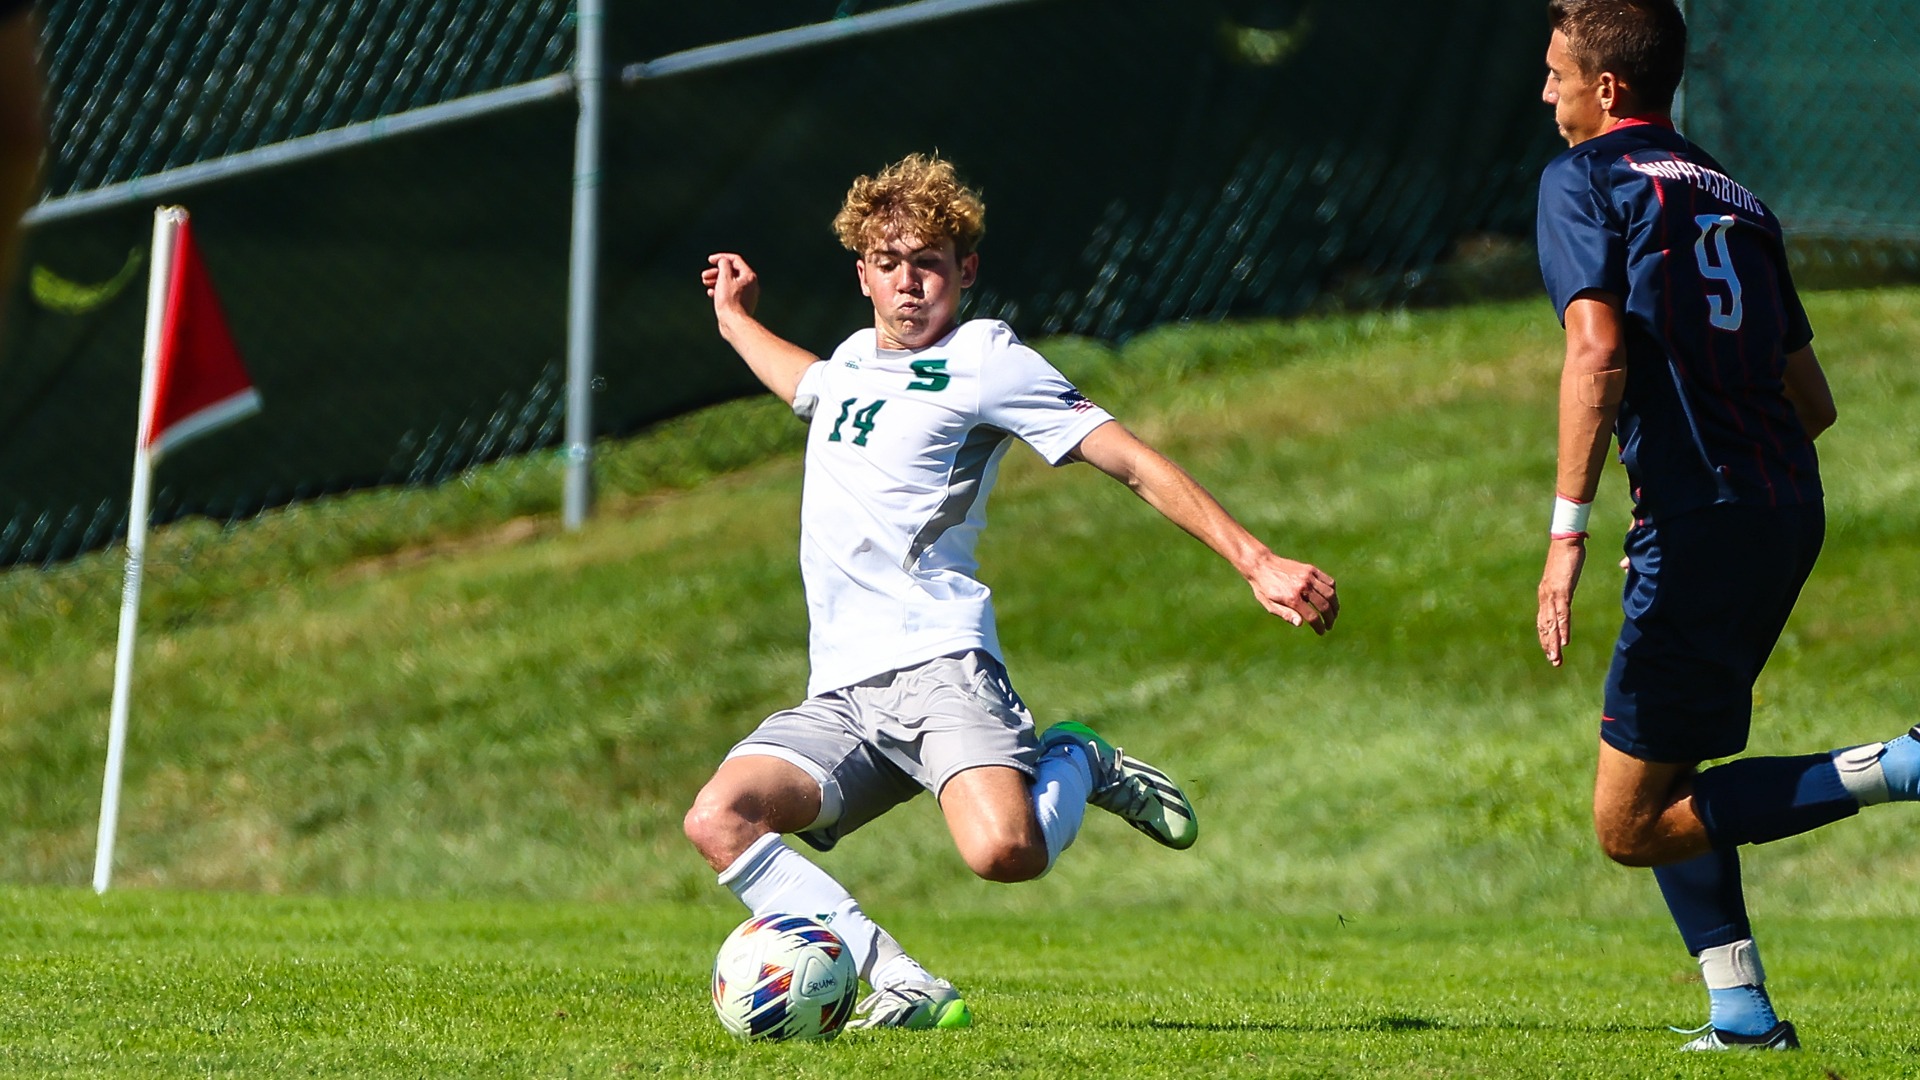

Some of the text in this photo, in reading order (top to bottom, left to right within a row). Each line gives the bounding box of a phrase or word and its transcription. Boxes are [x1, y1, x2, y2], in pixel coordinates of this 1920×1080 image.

[1694, 214, 1743, 332] 9
[905, 358, 951, 392] S
[827, 397, 888, 447] 14
